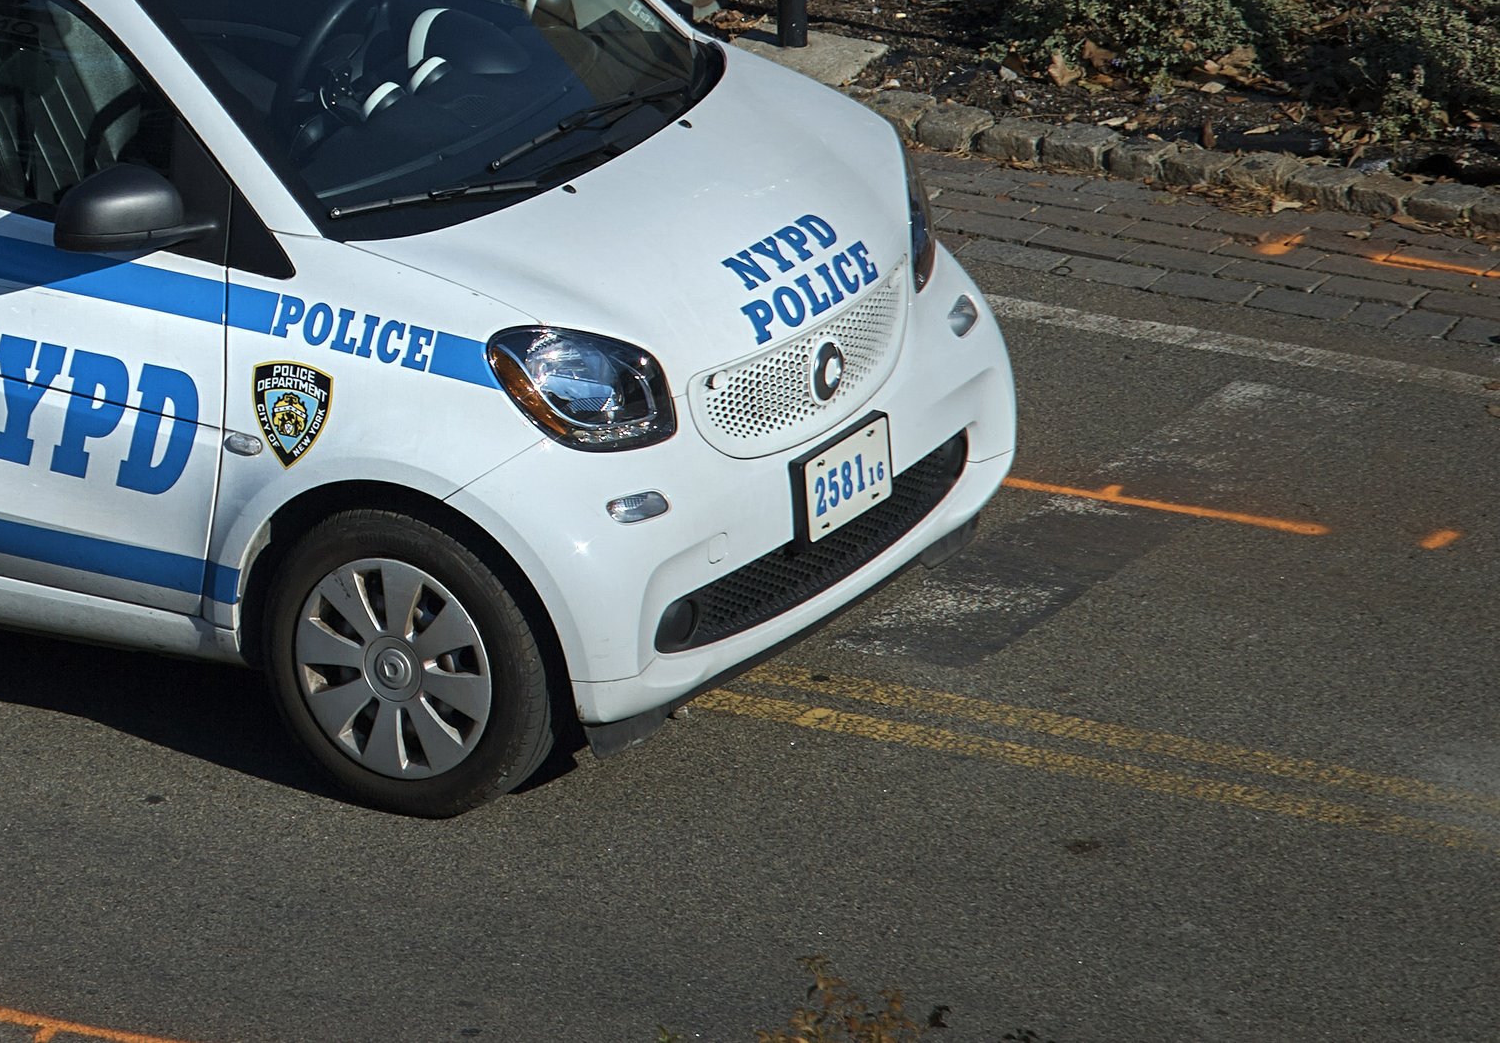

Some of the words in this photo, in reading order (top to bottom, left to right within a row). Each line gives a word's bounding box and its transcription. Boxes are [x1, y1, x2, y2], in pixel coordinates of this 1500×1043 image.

[721, 214, 837, 291] NYPD
[739, 240, 879, 345] POLICE
[272, 294, 434, 372] POLICE
[257, 377, 328, 402] DEPARTMENT
[273, 365, 316, 383] POLICE
[257, 404, 271, 431] CITY
[268, 434, 280, 448] OF
[292, 436, 311, 457] NEW
[309, 408, 325, 437] YORK
[815, 453, 865, 517] 2581
